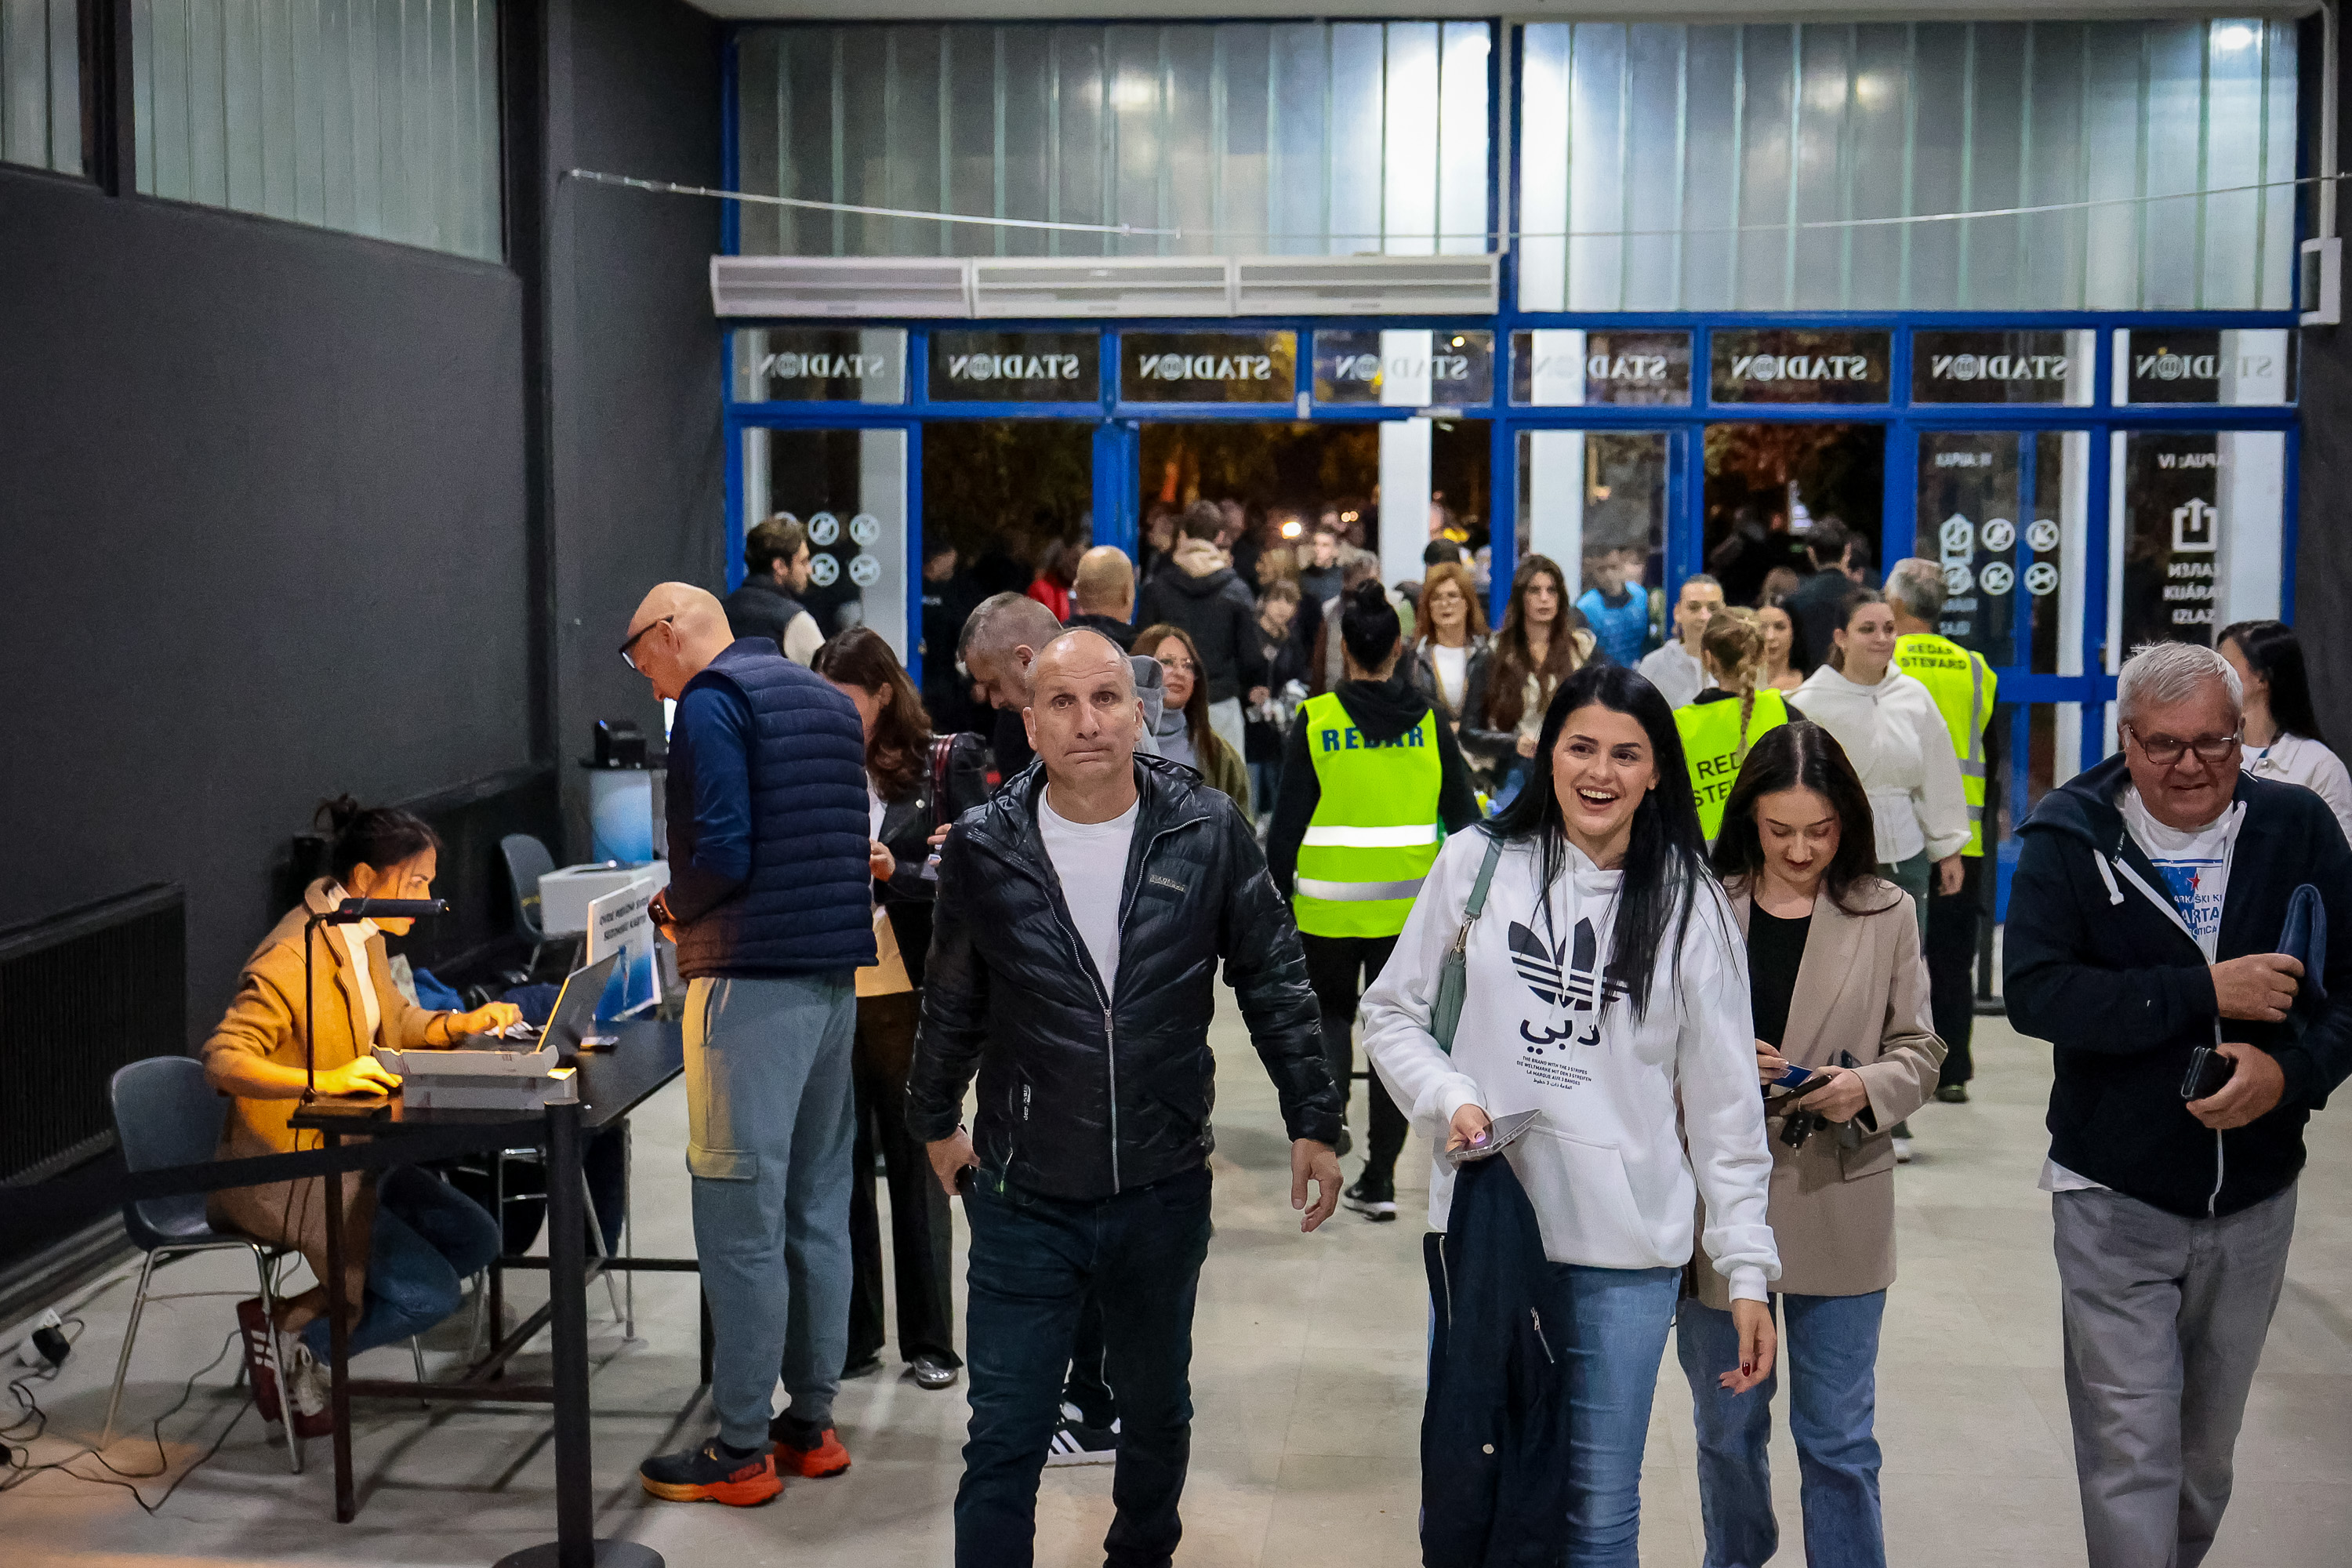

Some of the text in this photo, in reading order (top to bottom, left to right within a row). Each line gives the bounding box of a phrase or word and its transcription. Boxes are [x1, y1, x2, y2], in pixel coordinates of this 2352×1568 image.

[1694, 780, 1733, 808] STE
[1524, 1062, 1551, 1073] WELTMARKE
[1572, 1073, 1592, 1082] STREIFEN
[1533, 1071, 1551, 1080] MARQUE
